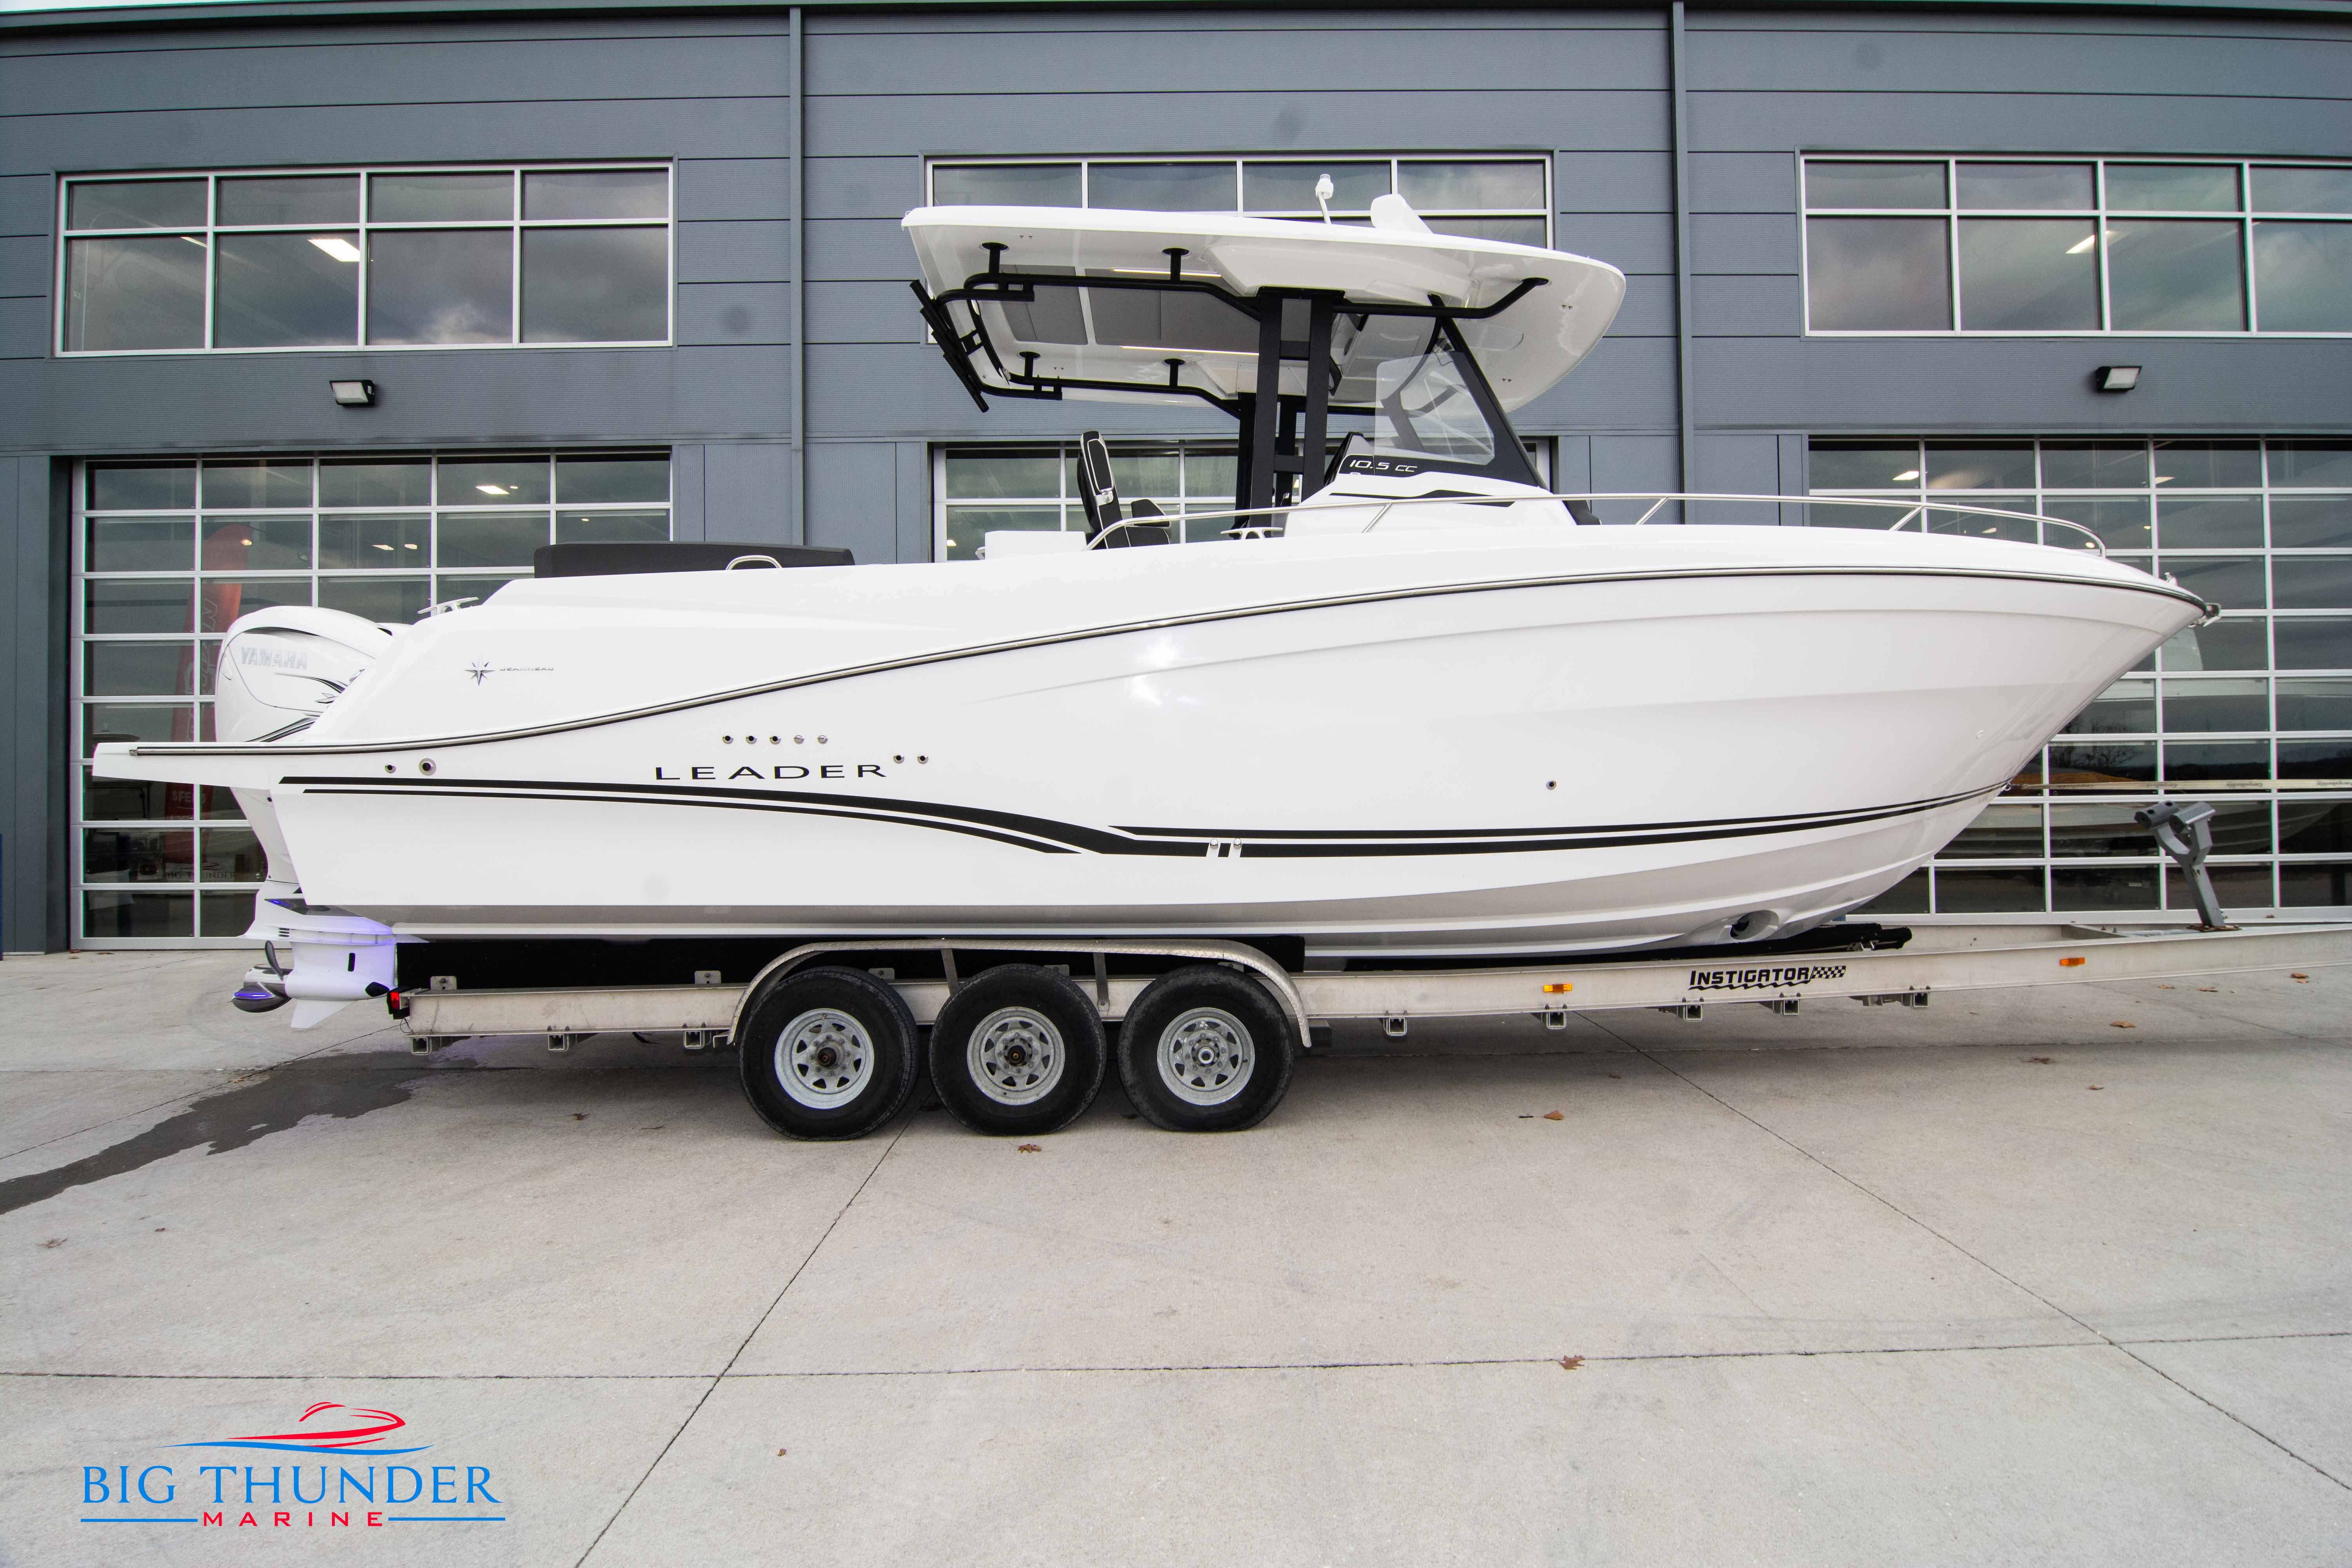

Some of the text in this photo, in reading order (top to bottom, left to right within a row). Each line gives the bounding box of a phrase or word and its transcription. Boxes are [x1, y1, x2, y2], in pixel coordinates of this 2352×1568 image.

[1349, 459, 1390, 470] 10.5
[241, 646, 307, 670] YAMAHA
[655, 764, 886, 780] LEADER
[172, 790, 206, 804] SPED
[1690, 967, 1809, 985] INSTIGATOR
